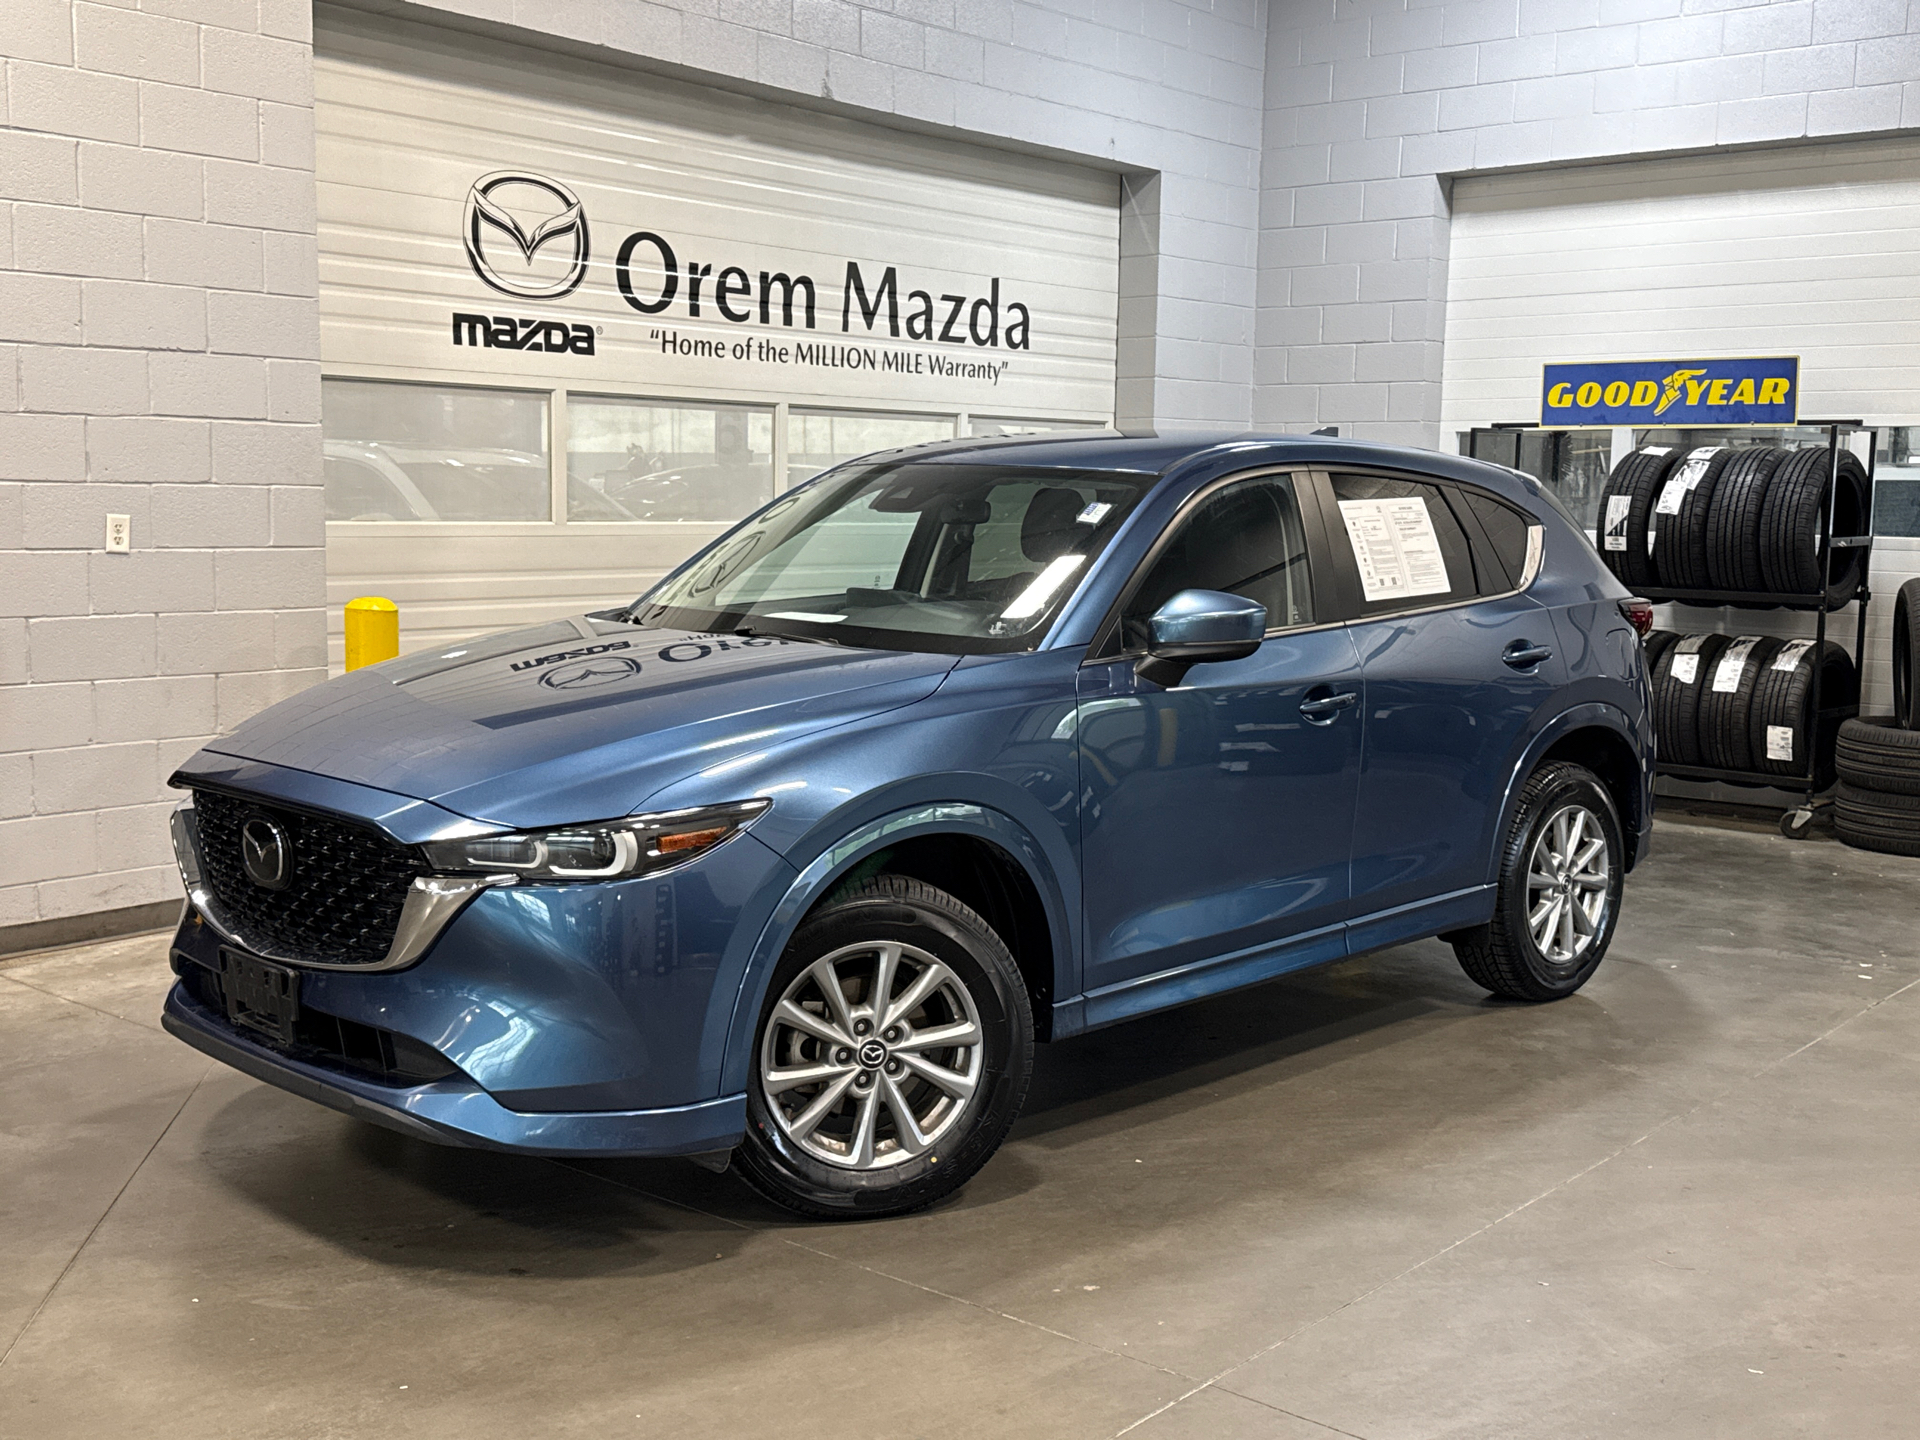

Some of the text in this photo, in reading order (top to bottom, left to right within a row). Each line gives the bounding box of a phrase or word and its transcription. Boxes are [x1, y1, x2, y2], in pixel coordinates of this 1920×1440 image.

[615, 231, 1030, 350] Orem Mazda
[732, 337, 754, 361] of
[757, 338, 789, 363] the
[795, 342, 876, 371] MILLION
[882, 350, 923, 374] MILE
